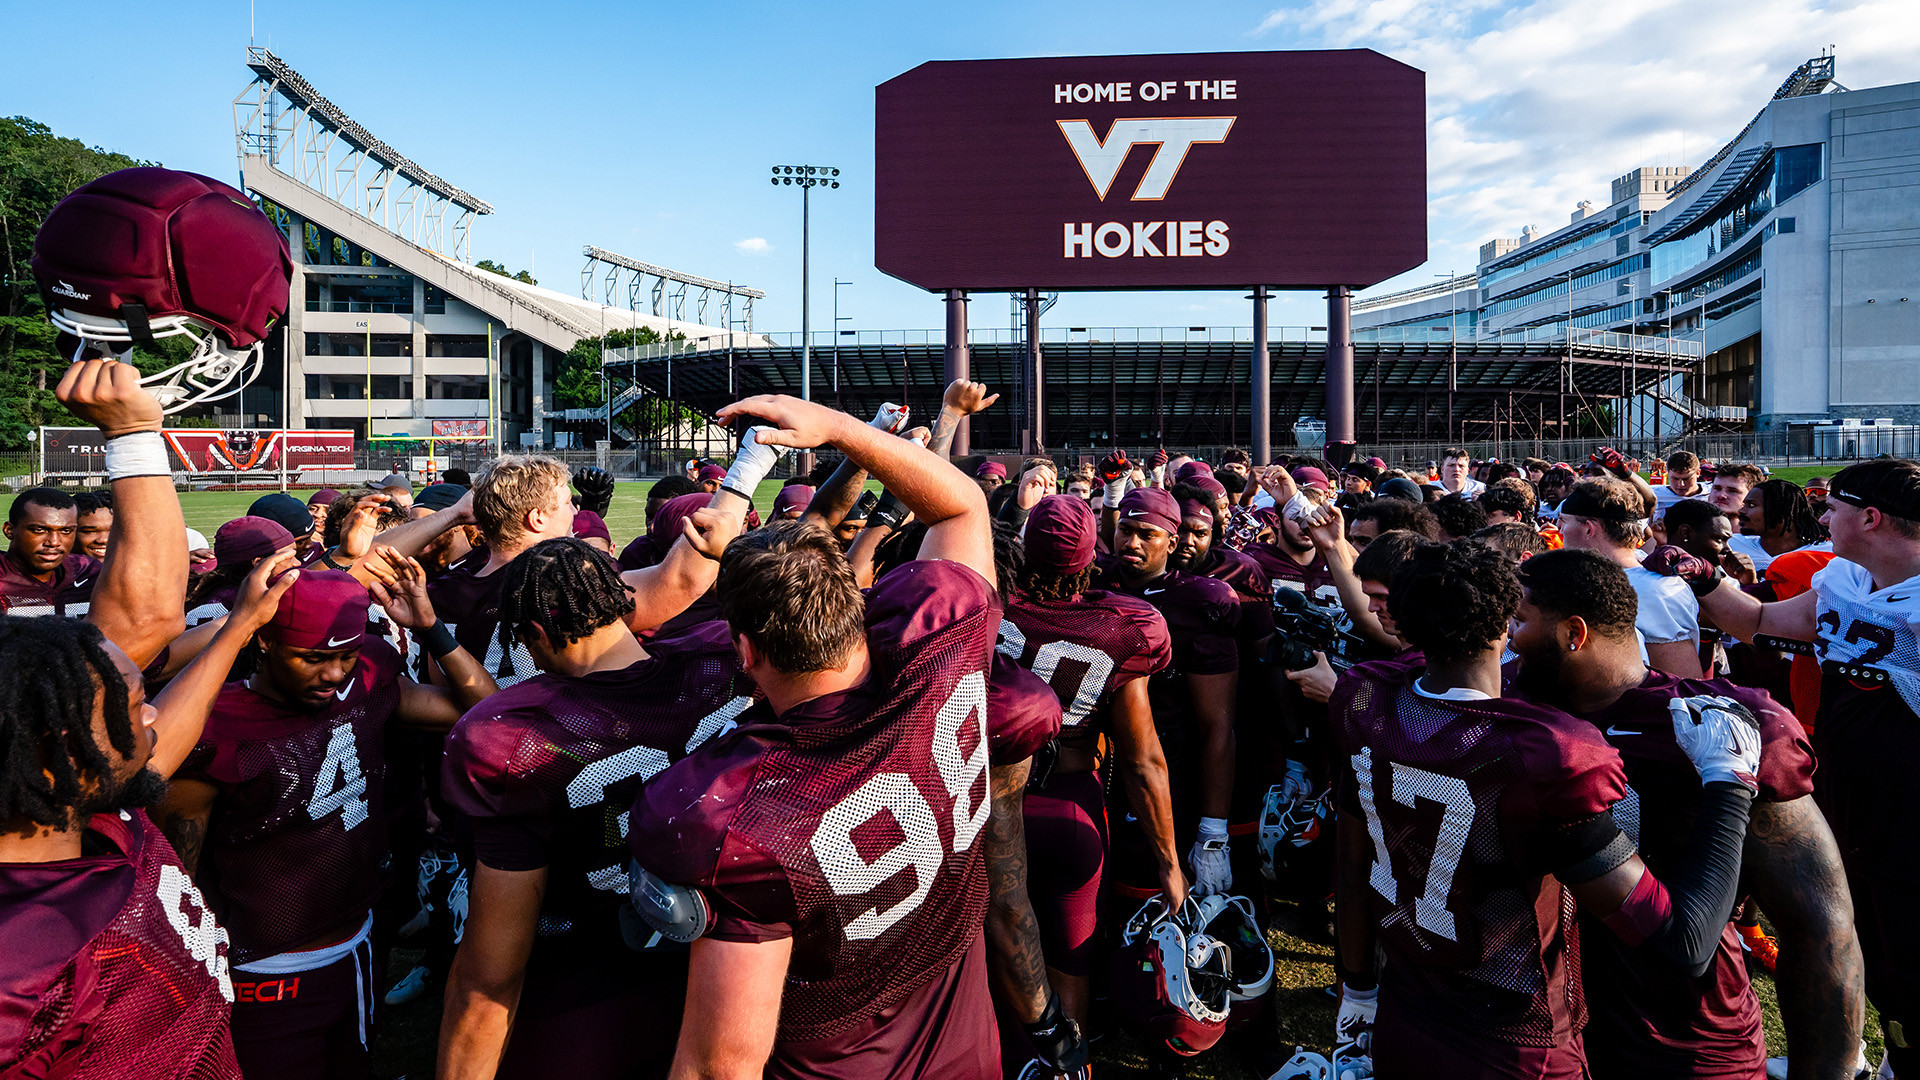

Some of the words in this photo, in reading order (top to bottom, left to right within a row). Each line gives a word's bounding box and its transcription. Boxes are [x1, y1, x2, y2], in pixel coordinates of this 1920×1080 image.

[1054, 81, 1132, 103] HOME
[1138, 81, 1177, 101] OF
[1184, 80, 1238, 100] THE
[1055, 115, 1238, 202] VT
[1063, 219, 1231, 259] HOKIES
[285, 445, 326, 453] VIRGINIA
[325, 445, 350, 453] TECH
[306, 722, 370, 832] 4
[810, 671, 992, 942] 98
[1350, 745, 1477, 943] 17
[233, 977, 300, 1003] ECH
